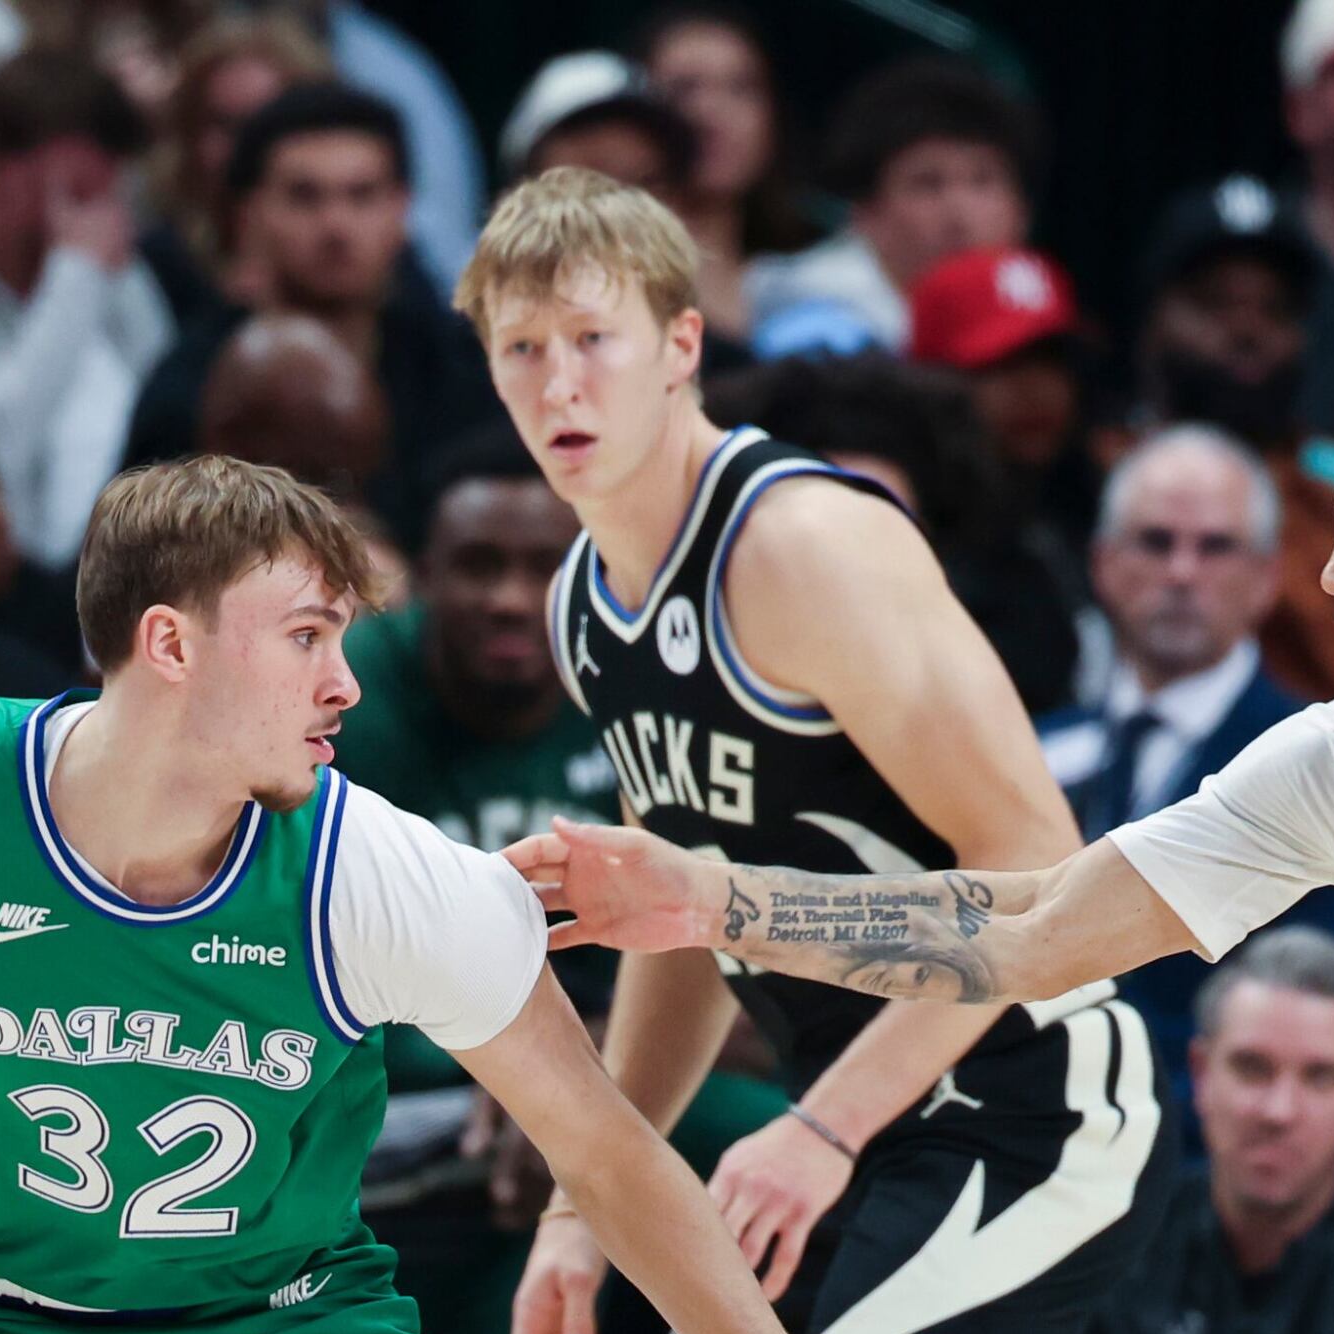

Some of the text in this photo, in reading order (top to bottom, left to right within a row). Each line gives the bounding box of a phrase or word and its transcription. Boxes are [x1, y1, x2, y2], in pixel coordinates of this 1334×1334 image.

[603, 711, 755, 826] UCKS
[832, 891, 863, 907] and
[869, 907, 908, 922] Place
[767, 924, 910, 943] Detroit, MI 48207
[190, 934, 287, 968] chime
[6, 1083, 257, 1240] 32
[268, 1273, 314, 1310] NIKE
